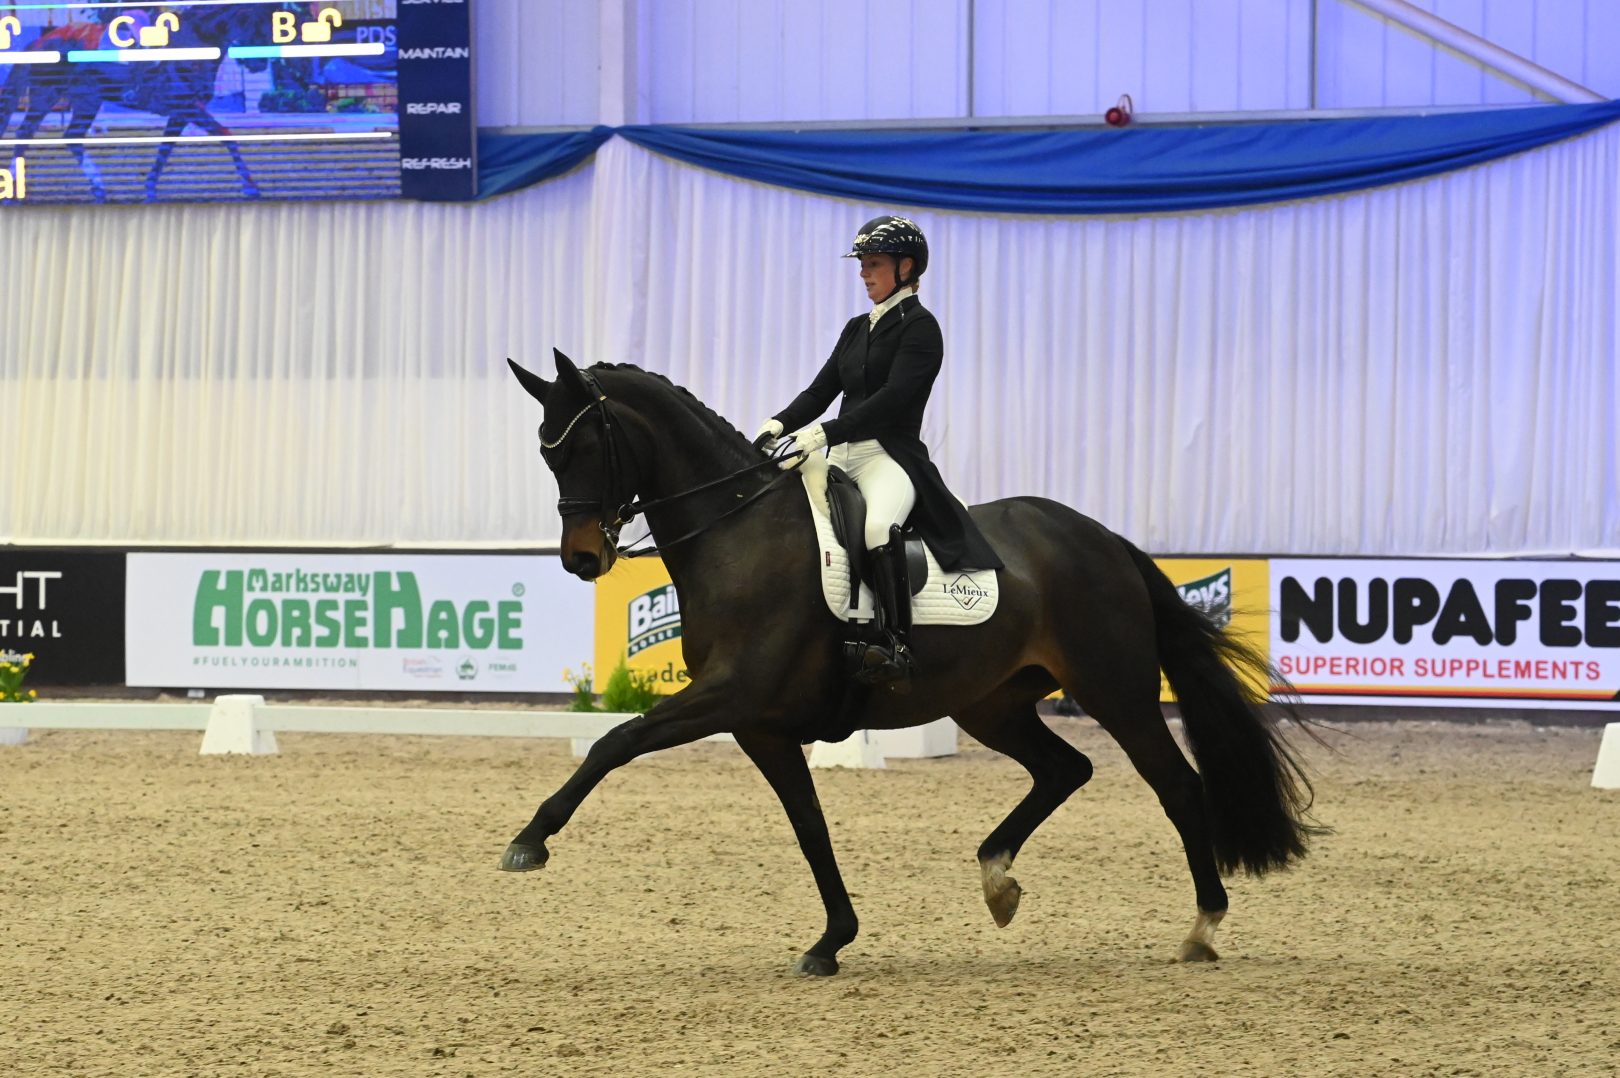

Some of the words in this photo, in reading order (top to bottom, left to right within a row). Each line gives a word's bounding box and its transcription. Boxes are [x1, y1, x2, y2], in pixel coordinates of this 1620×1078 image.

[108, 15, 135, 47] C
[272, 11, 297, 43] B
[398, 48, 469, 59] MAINTAIN
[406, 102, 461, 114] REPAIR
[246, 568, 370, 597] Marksway
[943, 583, 988, 597] LeMieux
[1280, 576, 1620, 648] NUPAFEE
[192, 656, 358, 668] #FUELYOURAMBITION
[1280, 655, 1405, 676] SUPERIOR
[1414, 658, 1601, 681] SUPPLEMENTS
